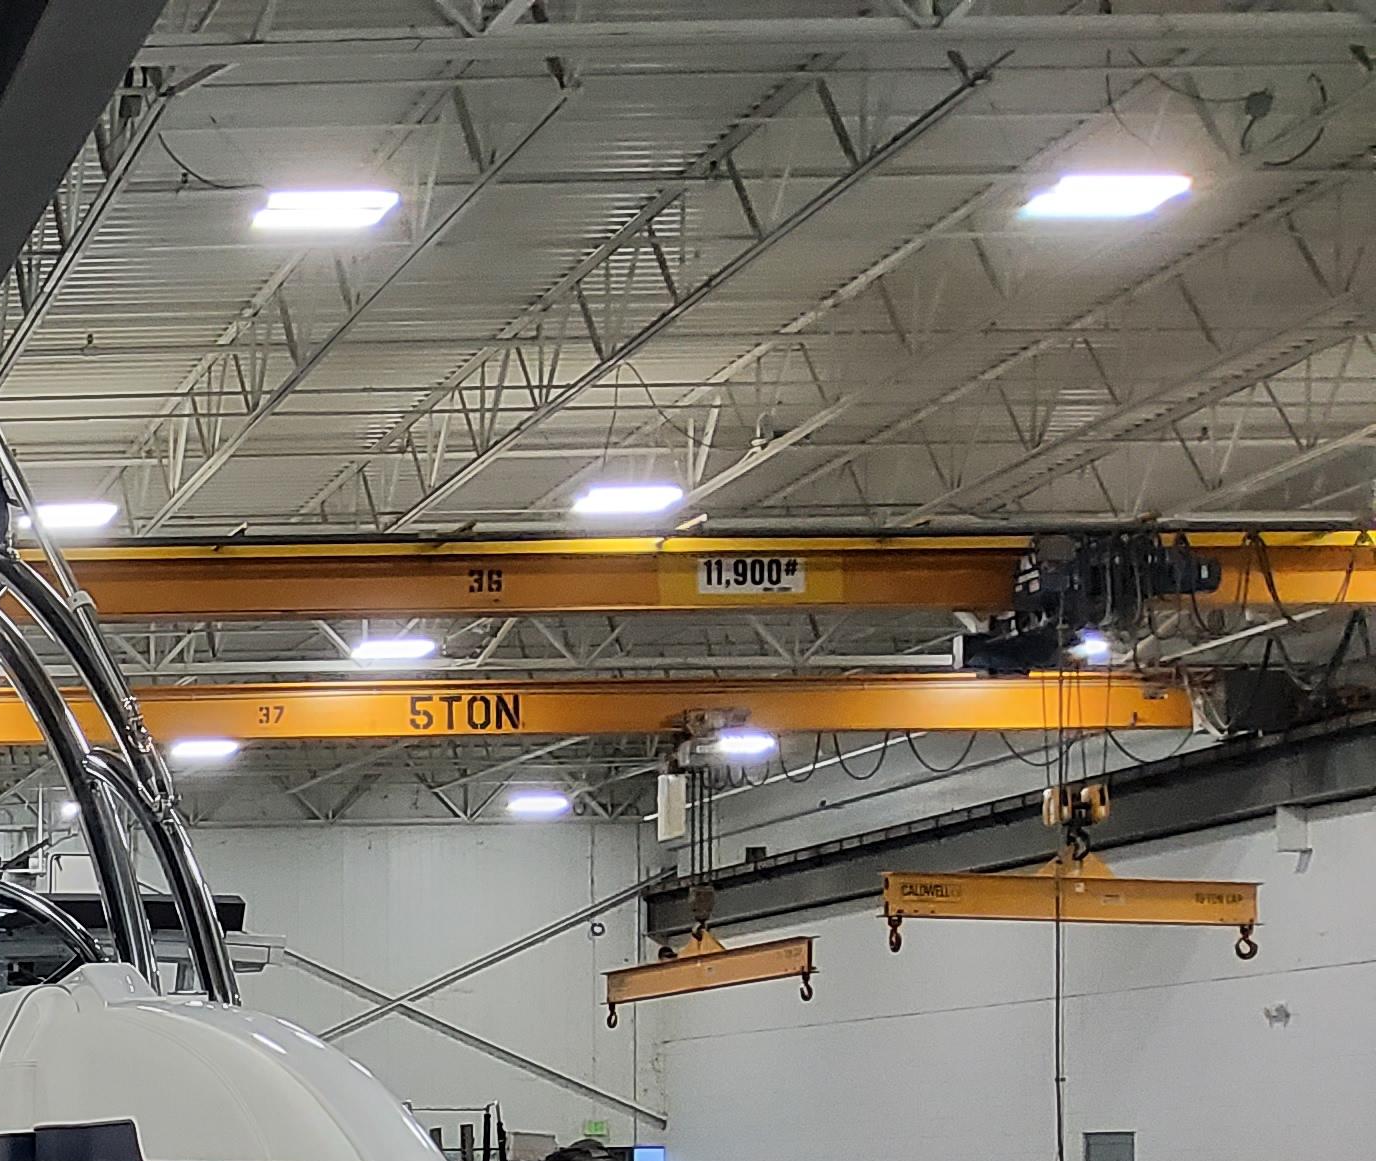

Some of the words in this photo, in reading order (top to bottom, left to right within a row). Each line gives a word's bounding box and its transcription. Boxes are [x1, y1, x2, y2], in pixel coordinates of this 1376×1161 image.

[468, 569, 502, 592] 36
[704, 559, 798, 588] 11,900#
[258, 706, 284, 724] 37
